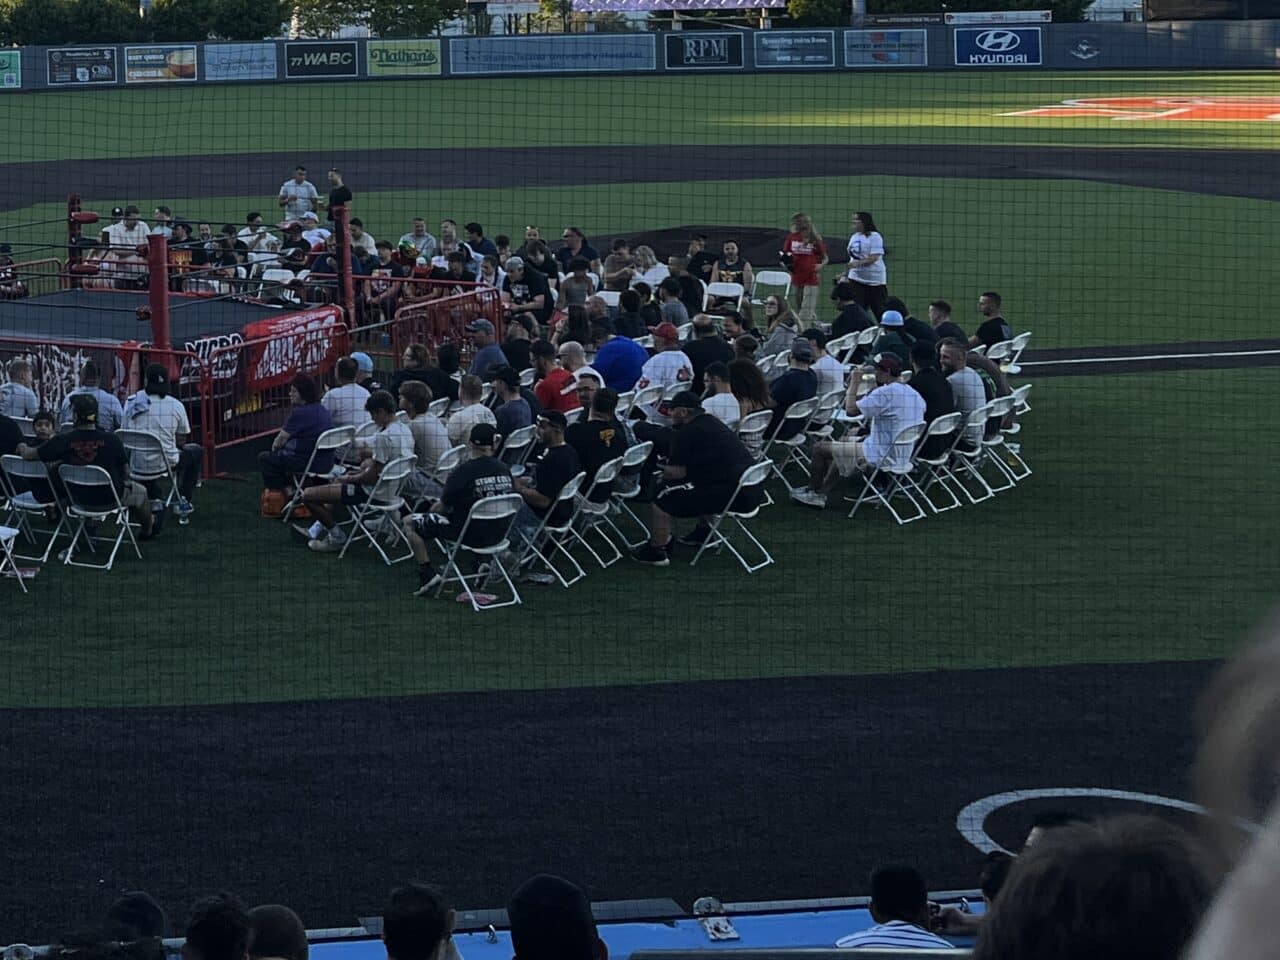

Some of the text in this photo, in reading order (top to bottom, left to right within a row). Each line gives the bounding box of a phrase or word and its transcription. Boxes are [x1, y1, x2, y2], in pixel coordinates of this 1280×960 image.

[370, 47, 437, 64] Nathan's
[685, 38, 726, 57] RPM
[303, 51, 353, 66] WABC
[969, 53, 1028, 64] HYUNDAI
